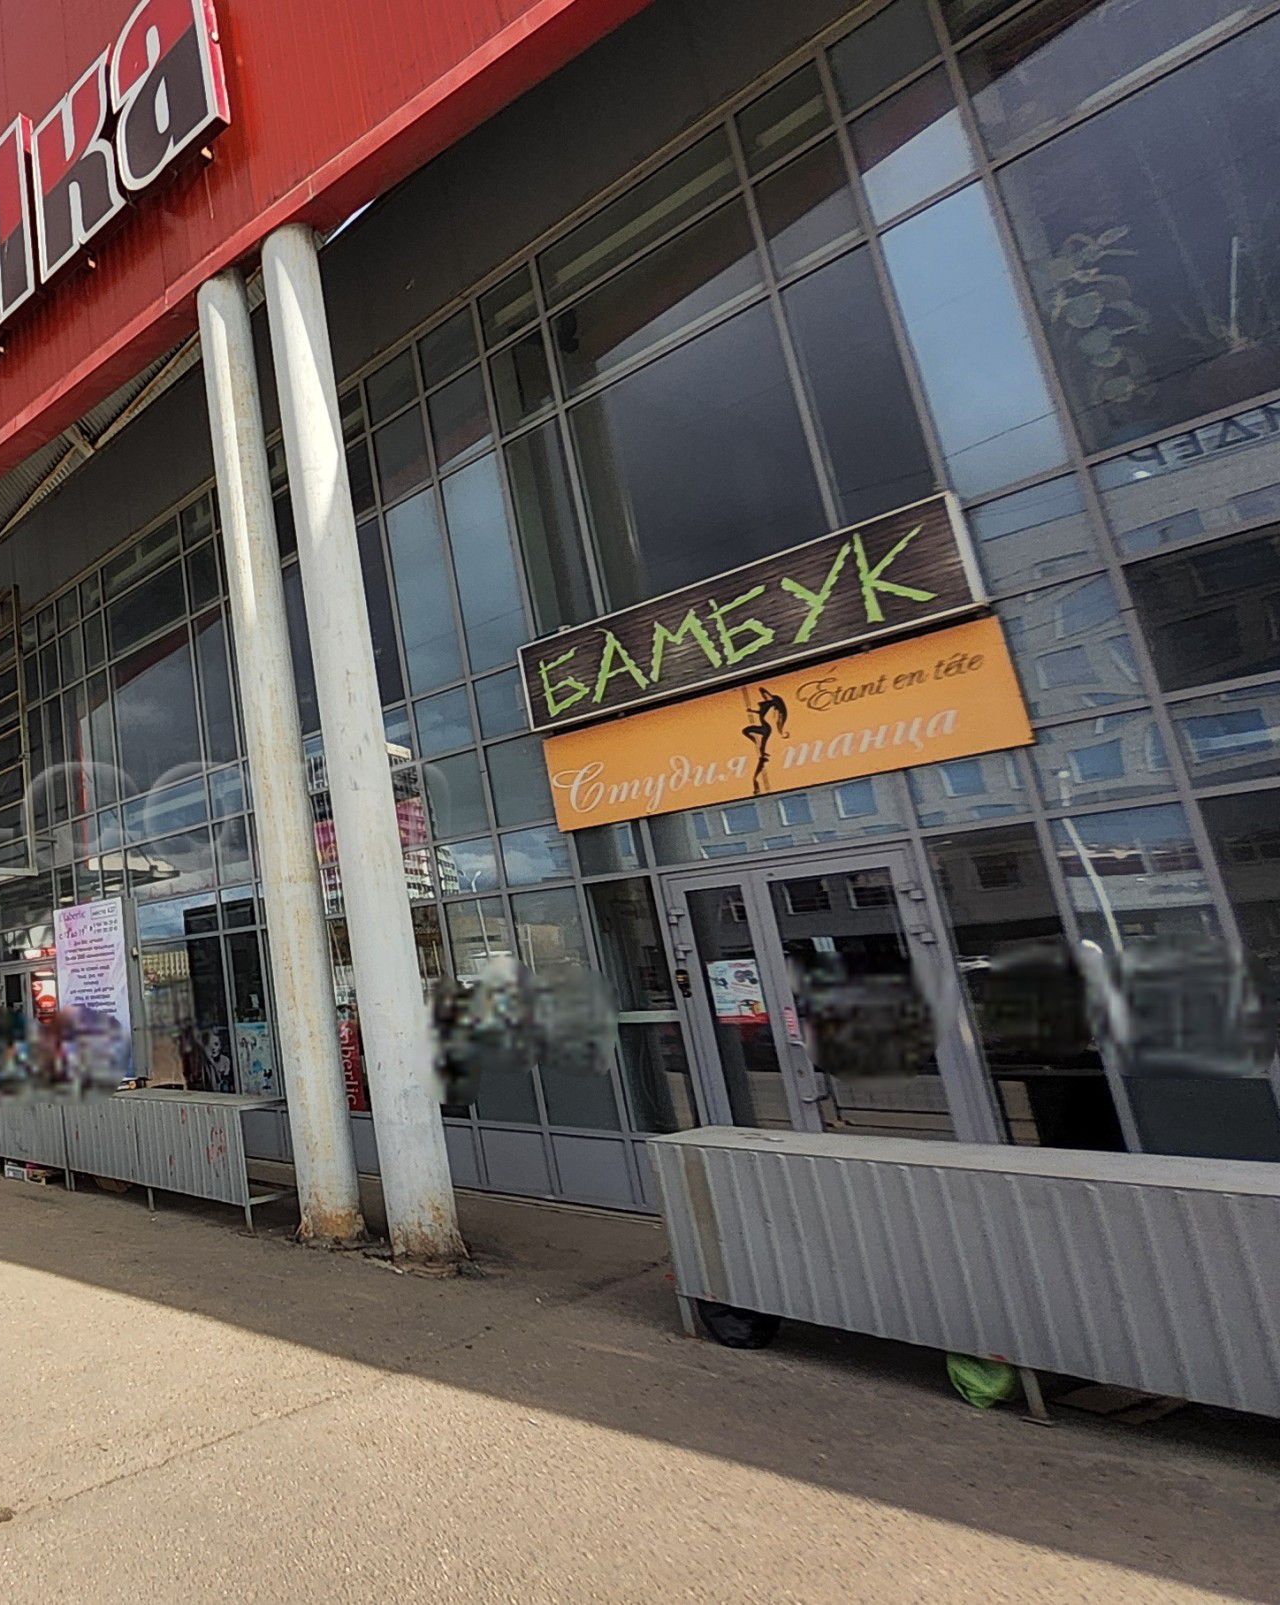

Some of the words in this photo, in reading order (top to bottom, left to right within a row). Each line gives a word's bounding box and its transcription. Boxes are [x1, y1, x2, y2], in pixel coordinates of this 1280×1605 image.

[538, 523, 937, 717] БАМБУК
[893, 669, 926, 690] en
[553, 756, 747, 814] Студия
[782, 709, 959, 769] танца
